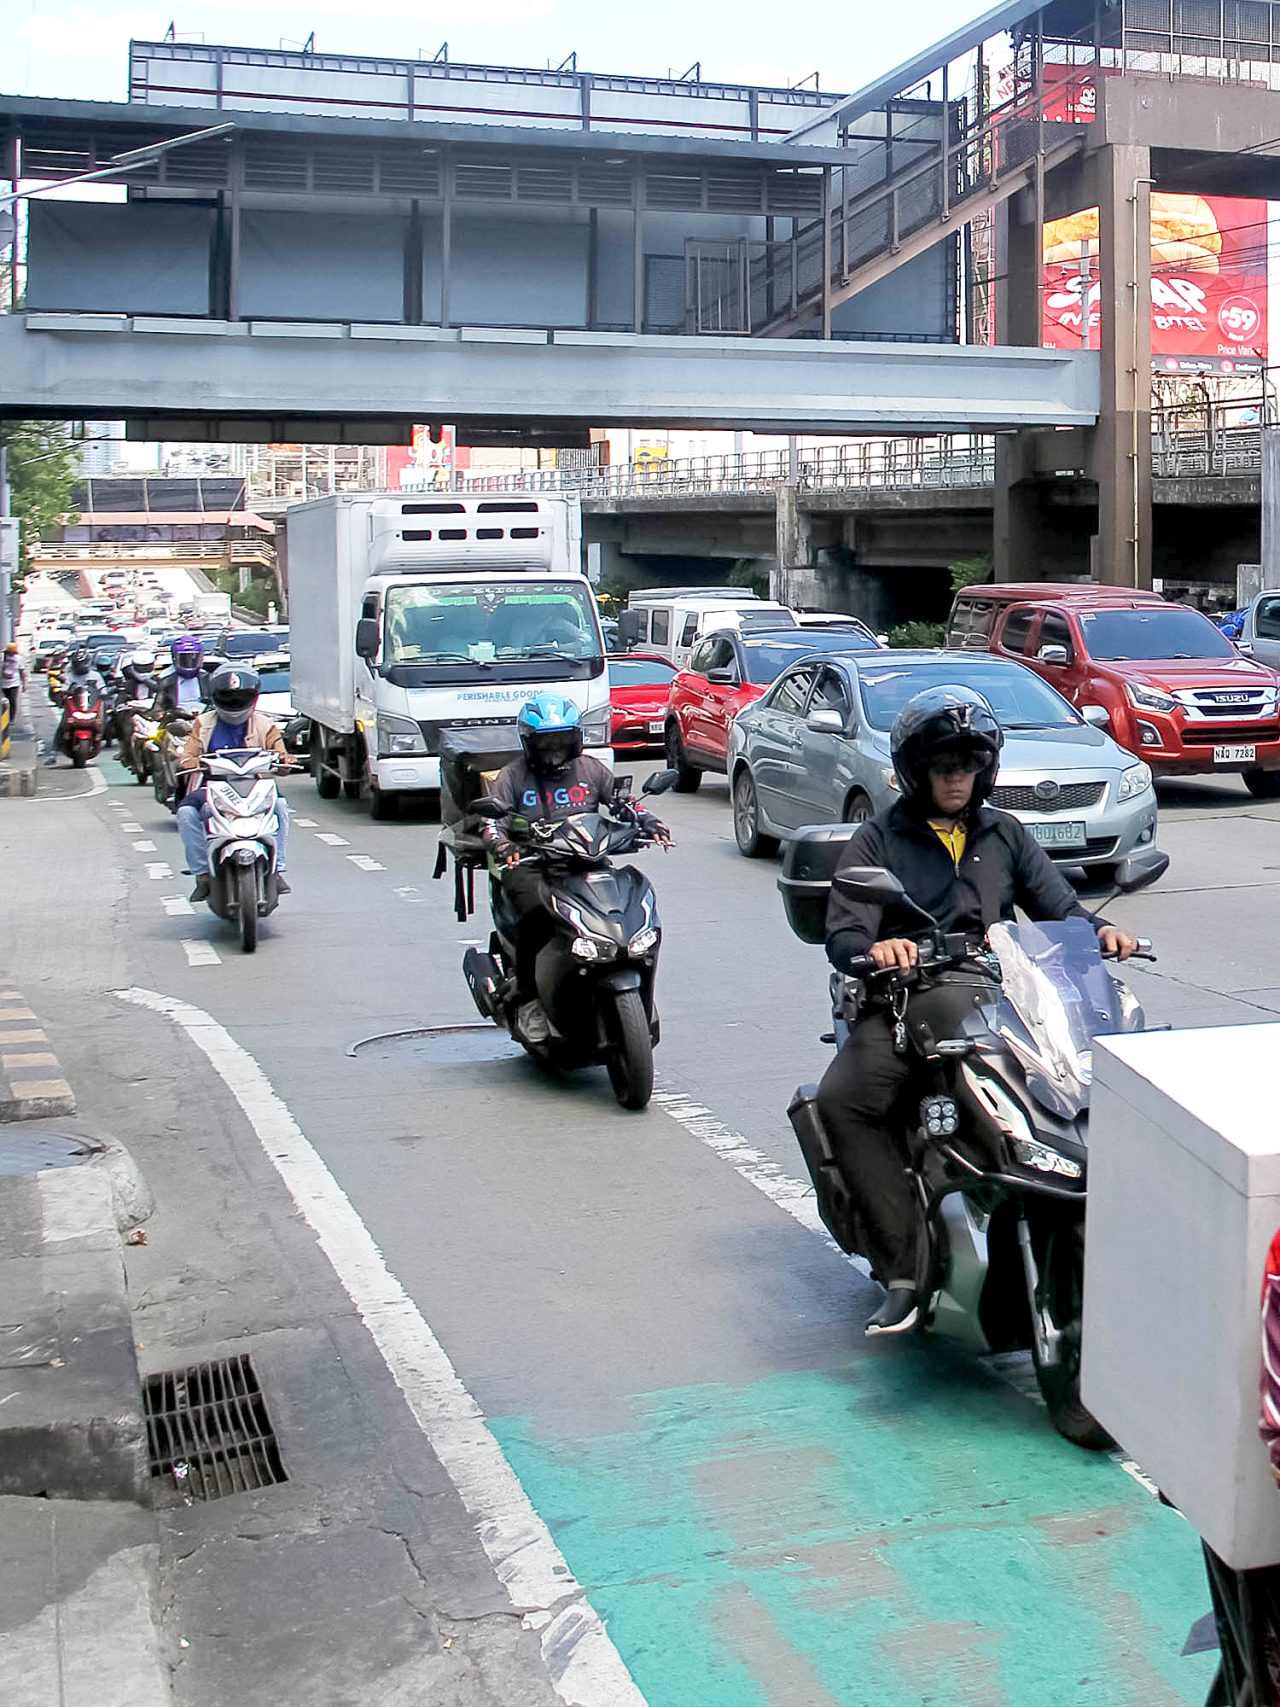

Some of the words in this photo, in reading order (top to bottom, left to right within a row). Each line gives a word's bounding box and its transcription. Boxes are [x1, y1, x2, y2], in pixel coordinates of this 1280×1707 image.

[1217, 343, 1236, 355] Price
[457, 690, 511, 701] PERISHABLE
[513, 689, 544, 699] GOOD
[1215, 694, 1249, 702] ISUZU
[451, 718, 517, 727] CANT
[1235, 748, 1255, 758] 7282
